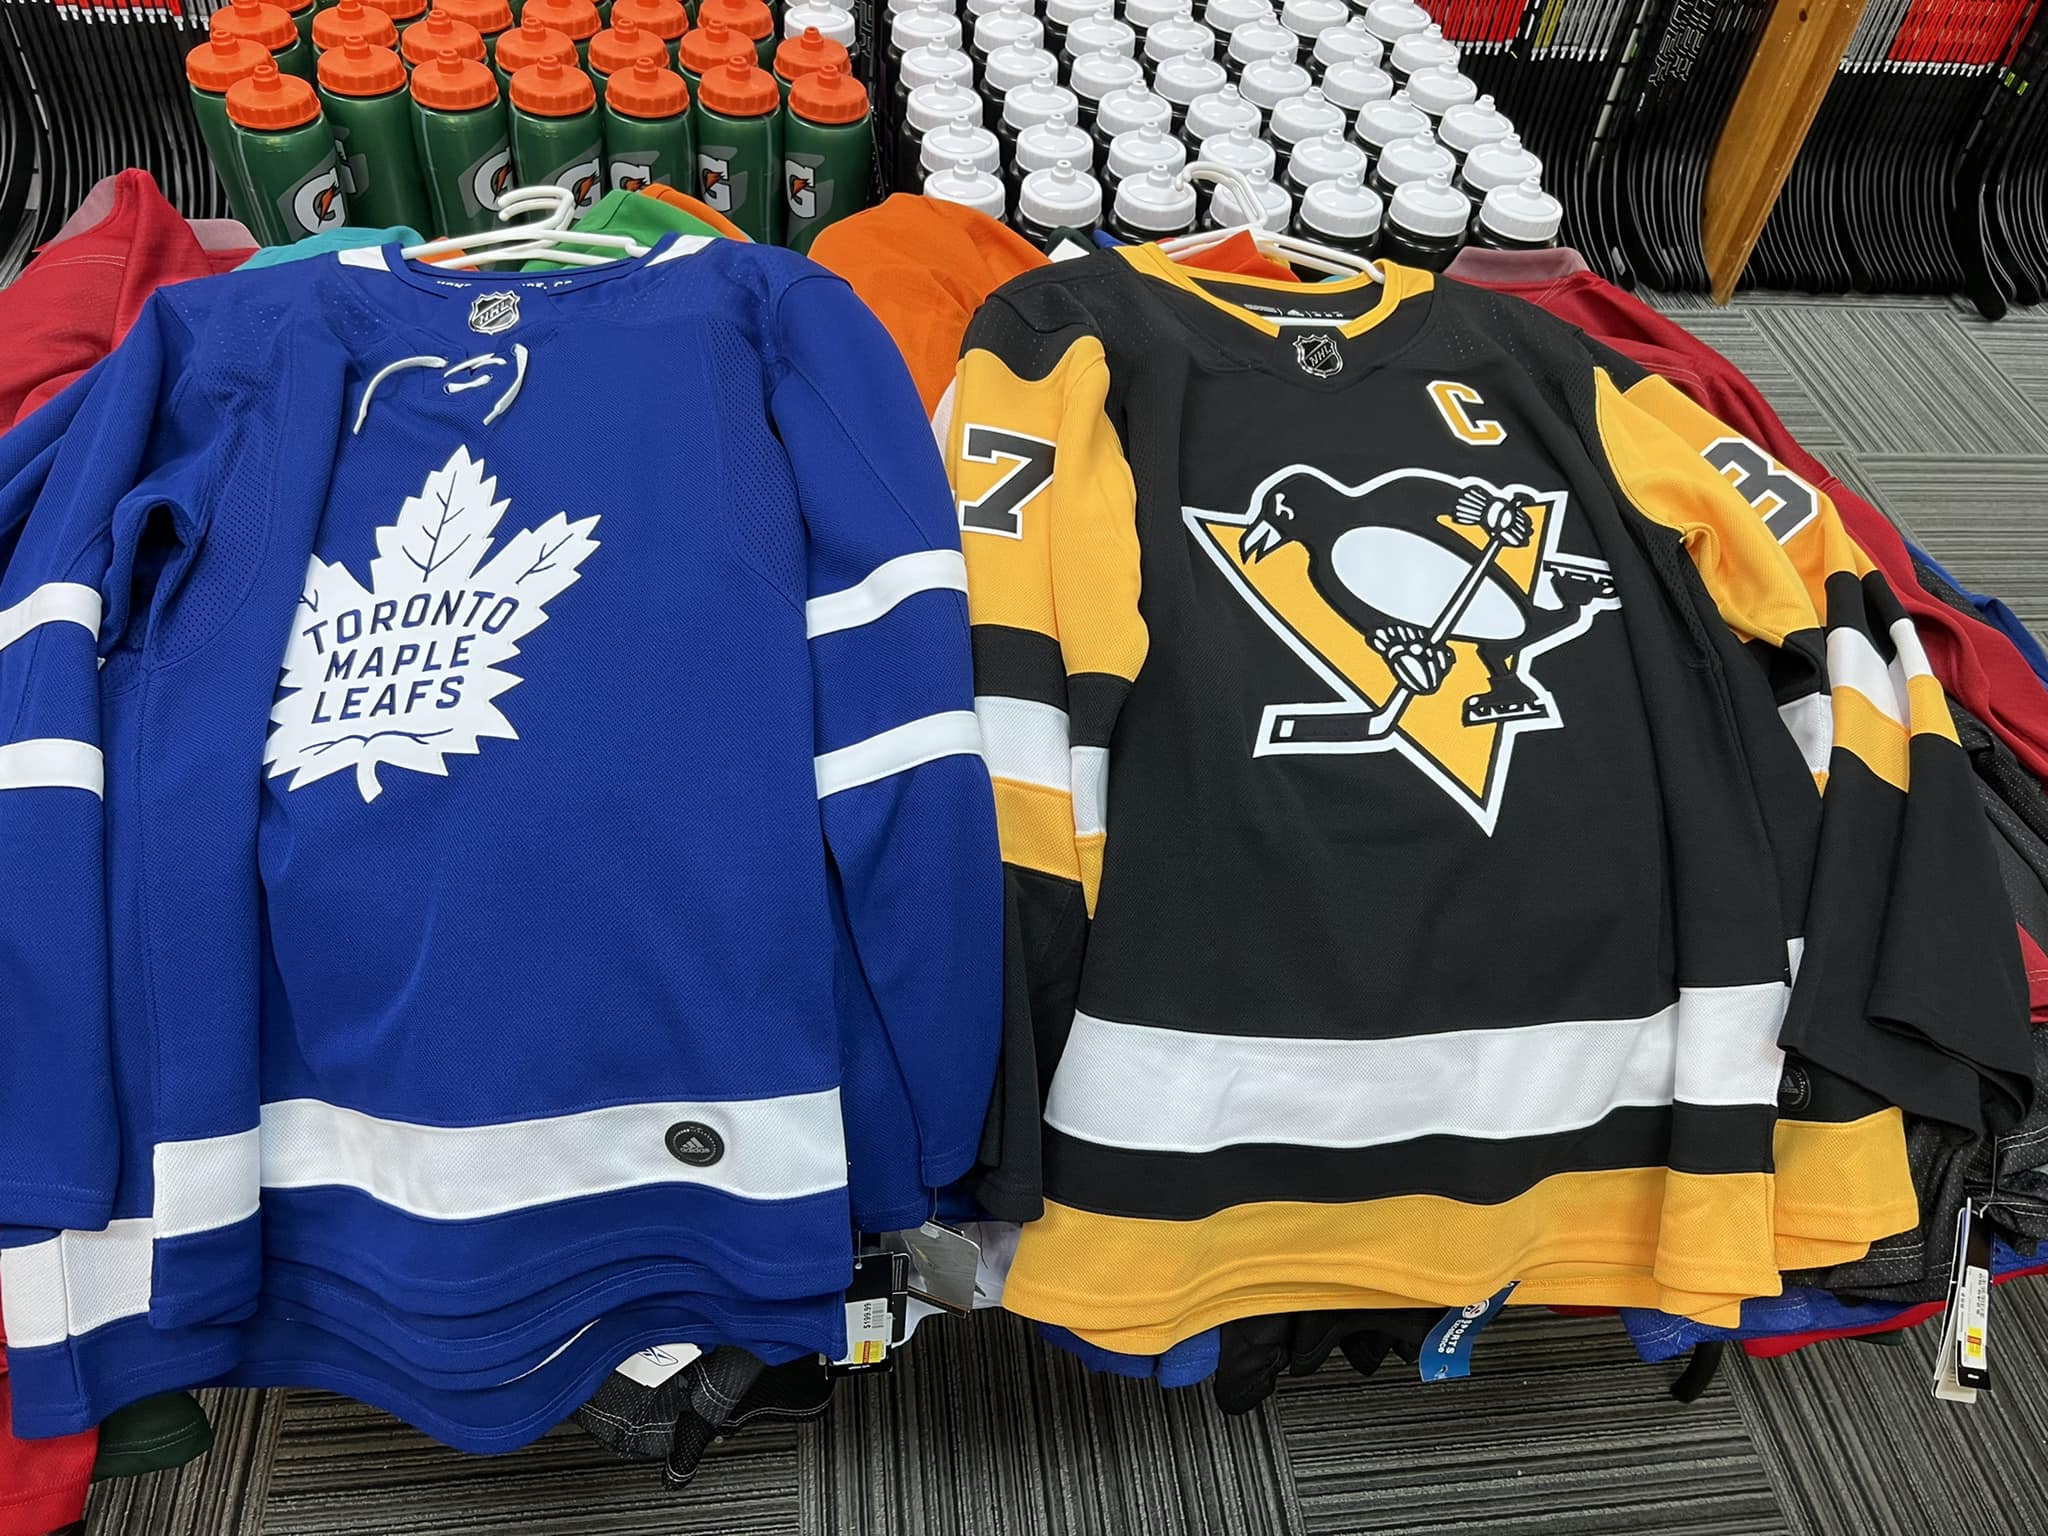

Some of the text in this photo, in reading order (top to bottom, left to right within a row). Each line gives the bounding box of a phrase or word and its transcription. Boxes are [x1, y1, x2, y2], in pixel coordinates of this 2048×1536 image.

[294, 166, 347, 235] G
[784, 159, 816, 219] G
[478, 301, 511, 325] NHL
[1308, 345, 1334, 367] NHL
[1426, 380, 1507, 446] C
[959, 423, 1057, 540] 7
[302, 589, 520, 655] TORONTO
[324, 634, 477, 683] MAPLE
[311, 675, 465, 724] LEAFS
